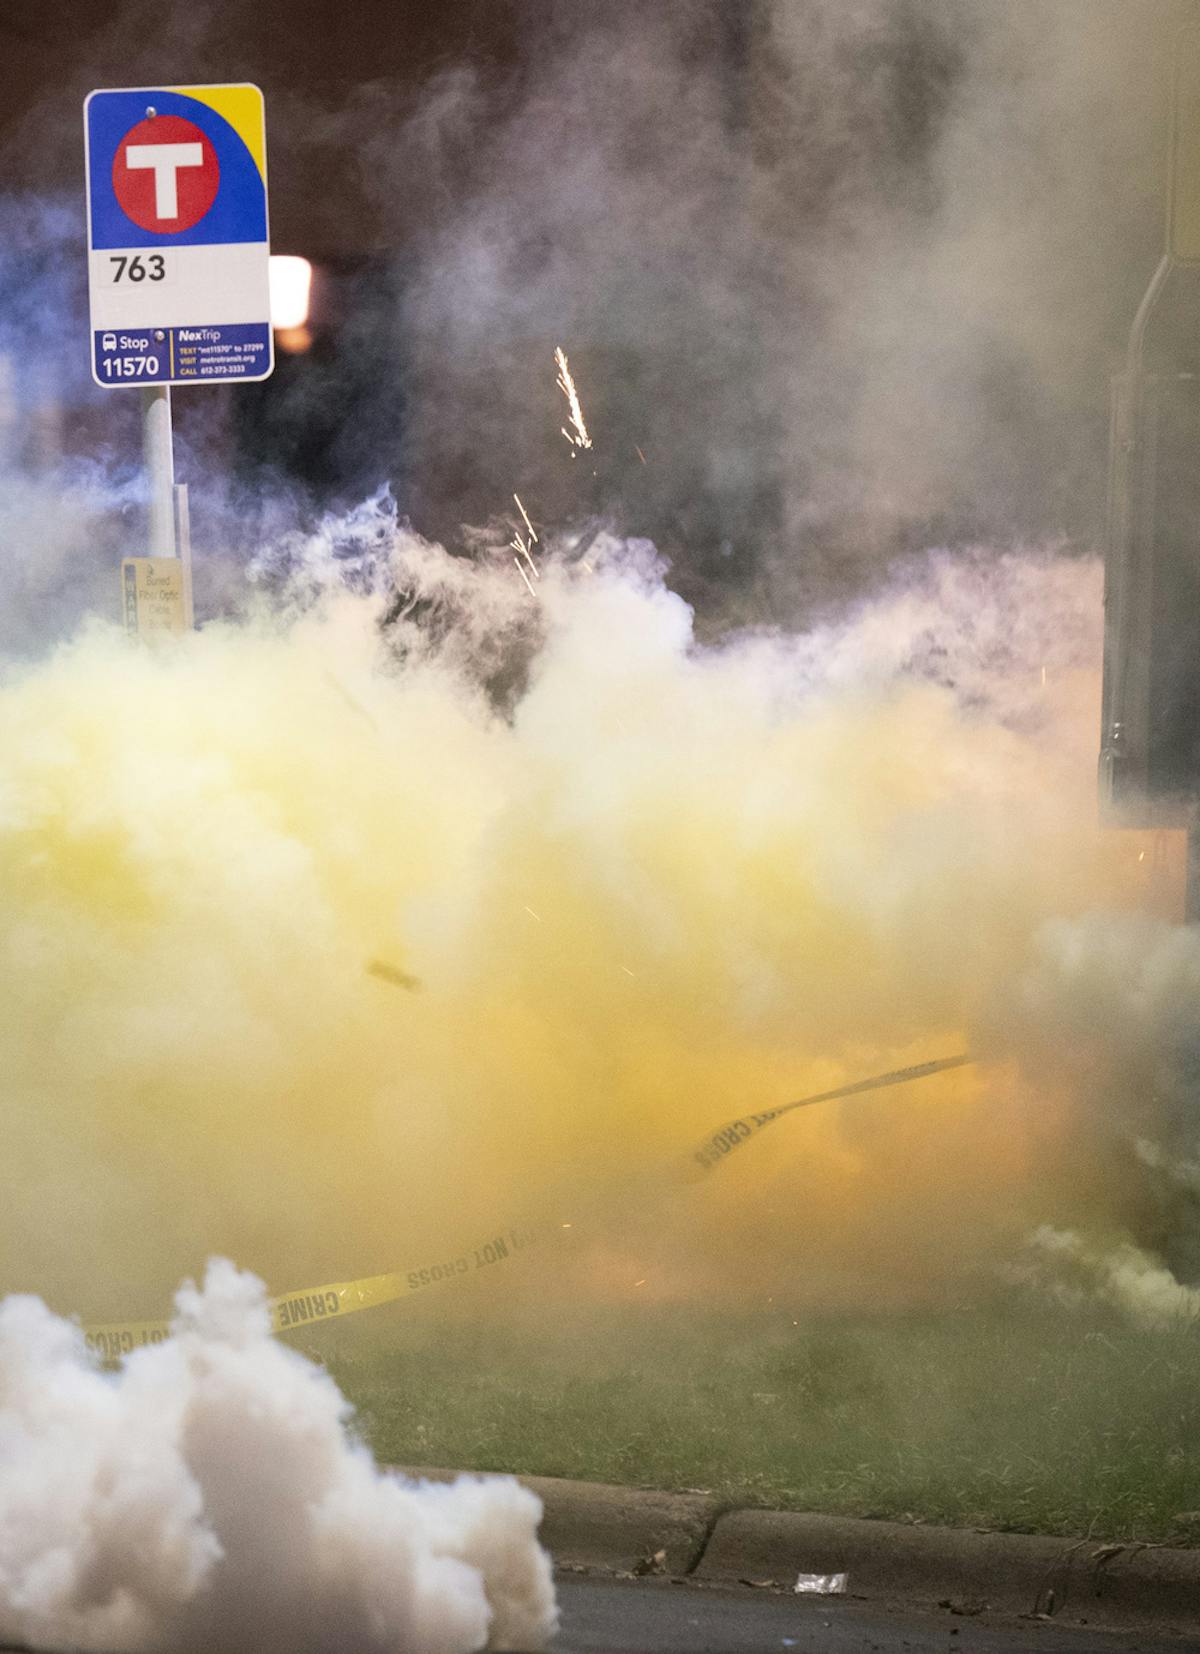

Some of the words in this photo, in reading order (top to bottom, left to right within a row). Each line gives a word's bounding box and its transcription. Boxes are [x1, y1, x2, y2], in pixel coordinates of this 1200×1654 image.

[126, 142, 203, 219] T
[110, 254, 166, 283] 763
[120, 335, 149, 352] Stop
[179, 329, 221, 343] NexTrip
[180, 347, 196, 355] TEXT
[200, 355, 256, 363] metrotransit.org
[103, 356, 159, 377] 11570
[180, 367, 197, 375] CALL
[473, 1236, 510, 1268] NOT
[407, 1261, 470, 1290] CROSS
[279, 1291, 340, 1328] CRIME
